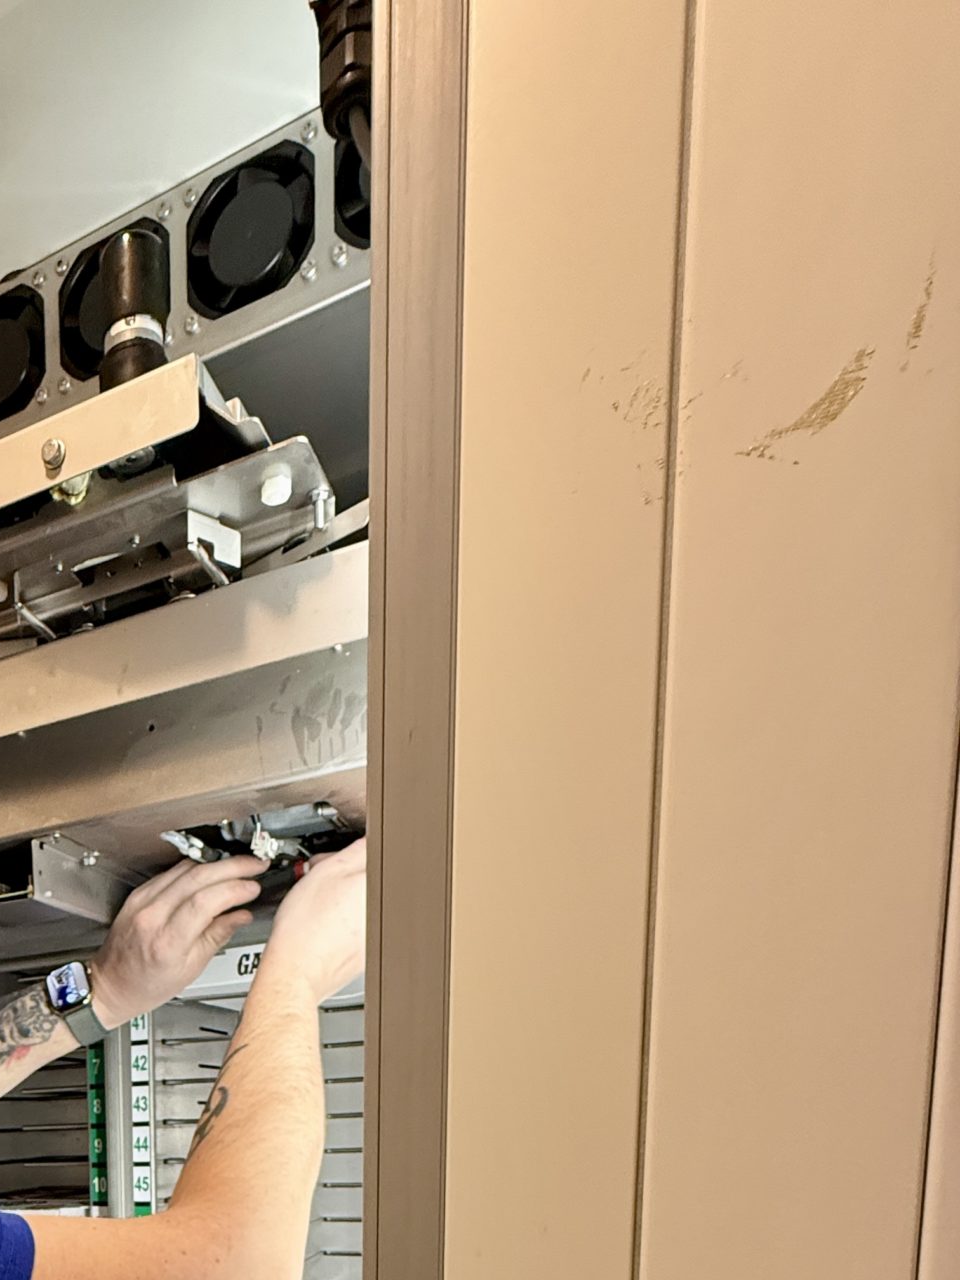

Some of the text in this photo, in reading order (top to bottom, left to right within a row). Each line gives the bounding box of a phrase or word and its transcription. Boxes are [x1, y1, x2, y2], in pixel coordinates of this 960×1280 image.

[132, 1013, 145, 1030] 41
[92, 1058, 100, 1074] 7
[132, 1056, 147, 1071] 42
[93, 1098, 102, 1114] 8
[132, 1096, 148, 1112] 43
[94, 1138, 102, 1154] 9
[134, 1136, 148, 1152] 44
[93, 1176, 106, 1192] 10
[134, 1176, 150, 1192] 45
